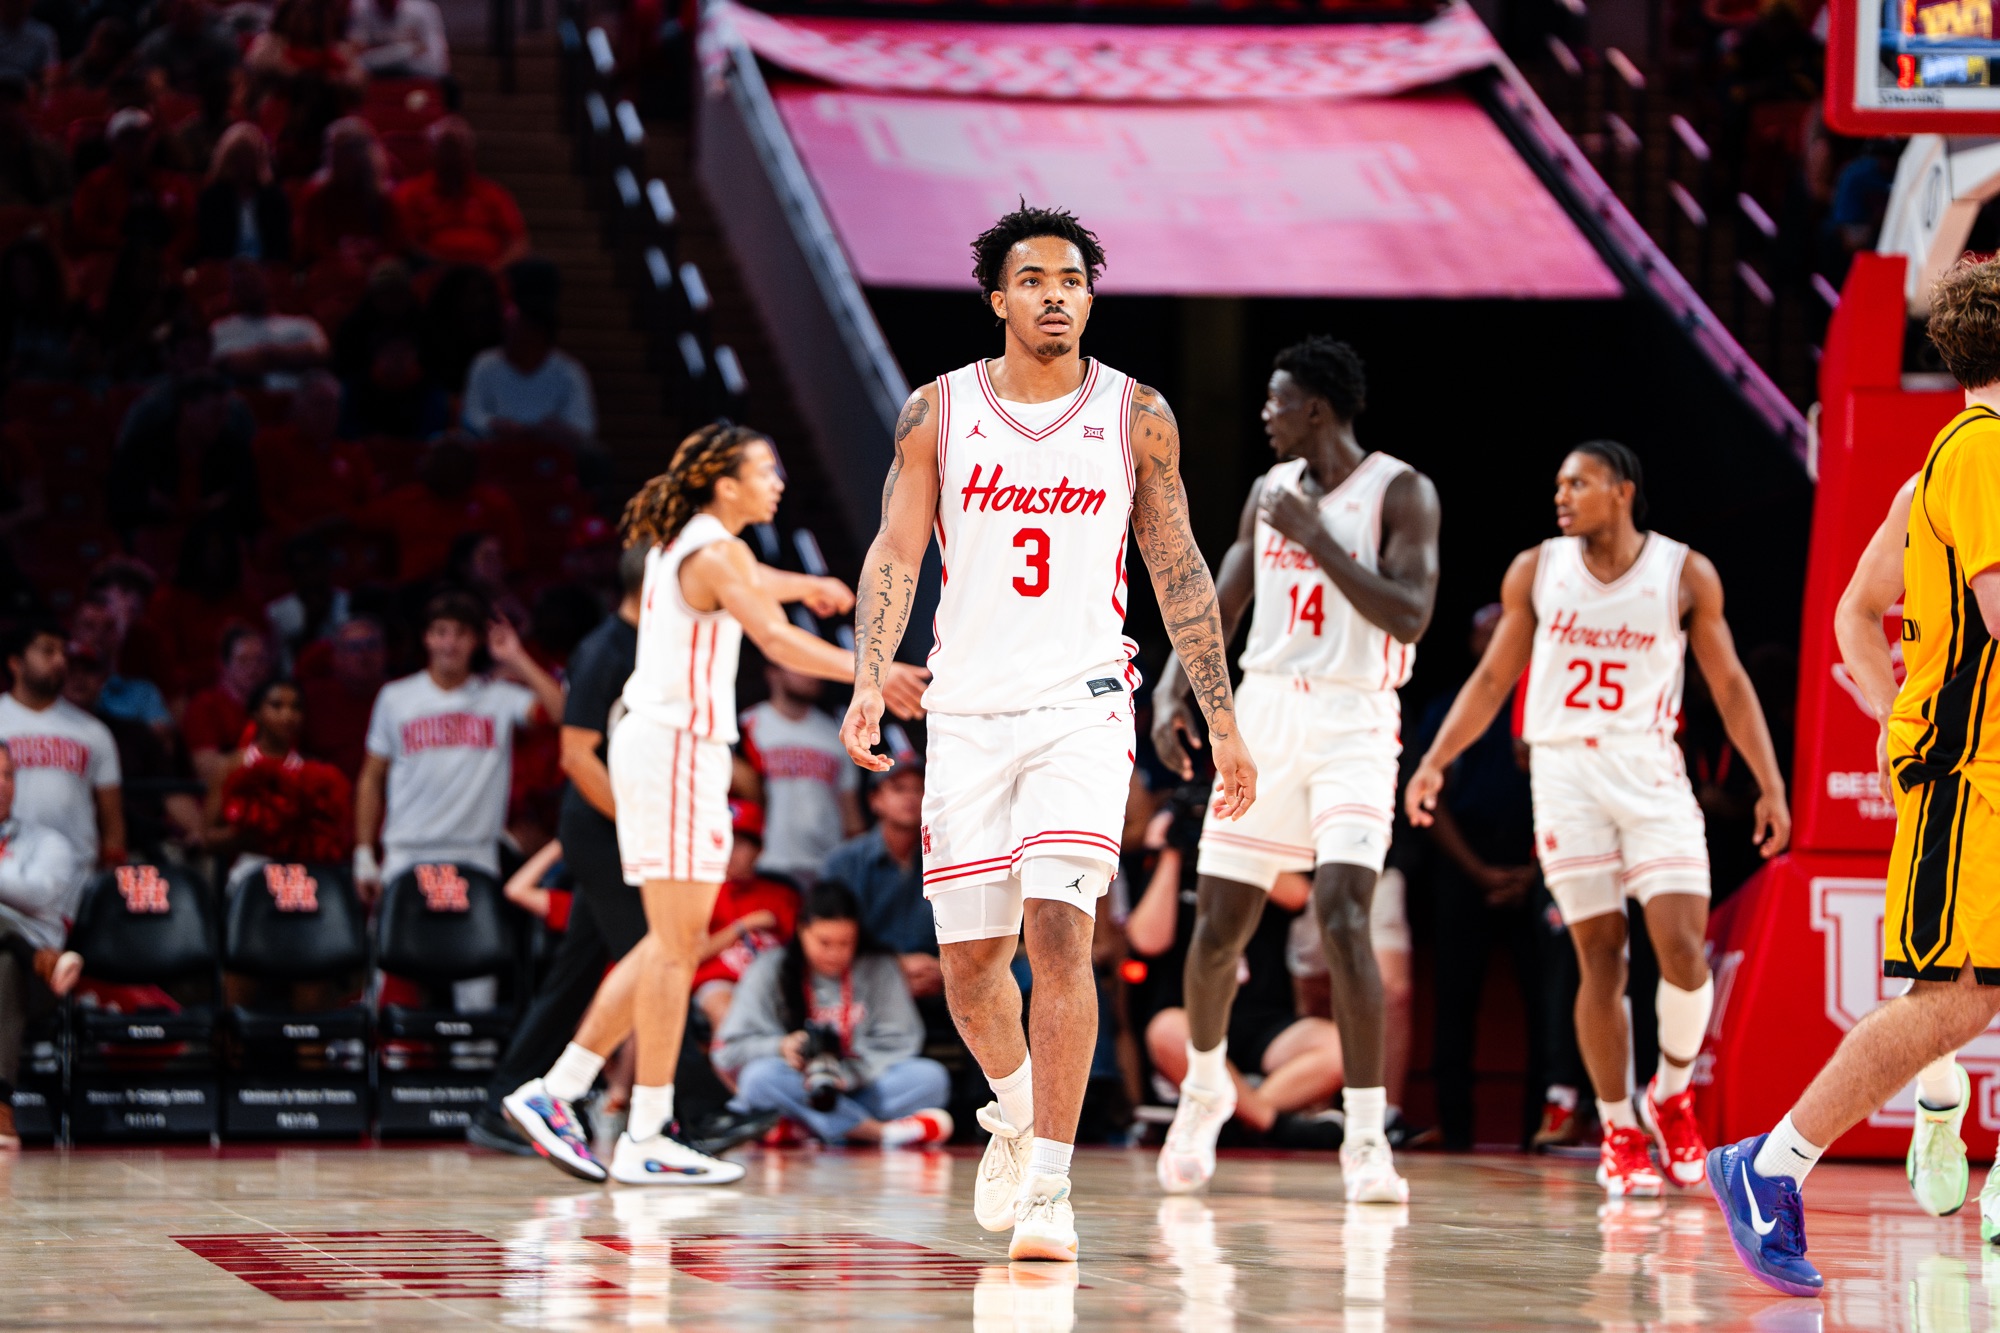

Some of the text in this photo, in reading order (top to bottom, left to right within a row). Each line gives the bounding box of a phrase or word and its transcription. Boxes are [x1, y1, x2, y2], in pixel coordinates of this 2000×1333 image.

[961, 463, 1107, 516] Houston
[1012, 527, 1051, 598] 3
[1287, 583, 1326, 637] 14
[1549, 608, 1657, 652] Houston
[1564, 658, 1628, 712] 25
